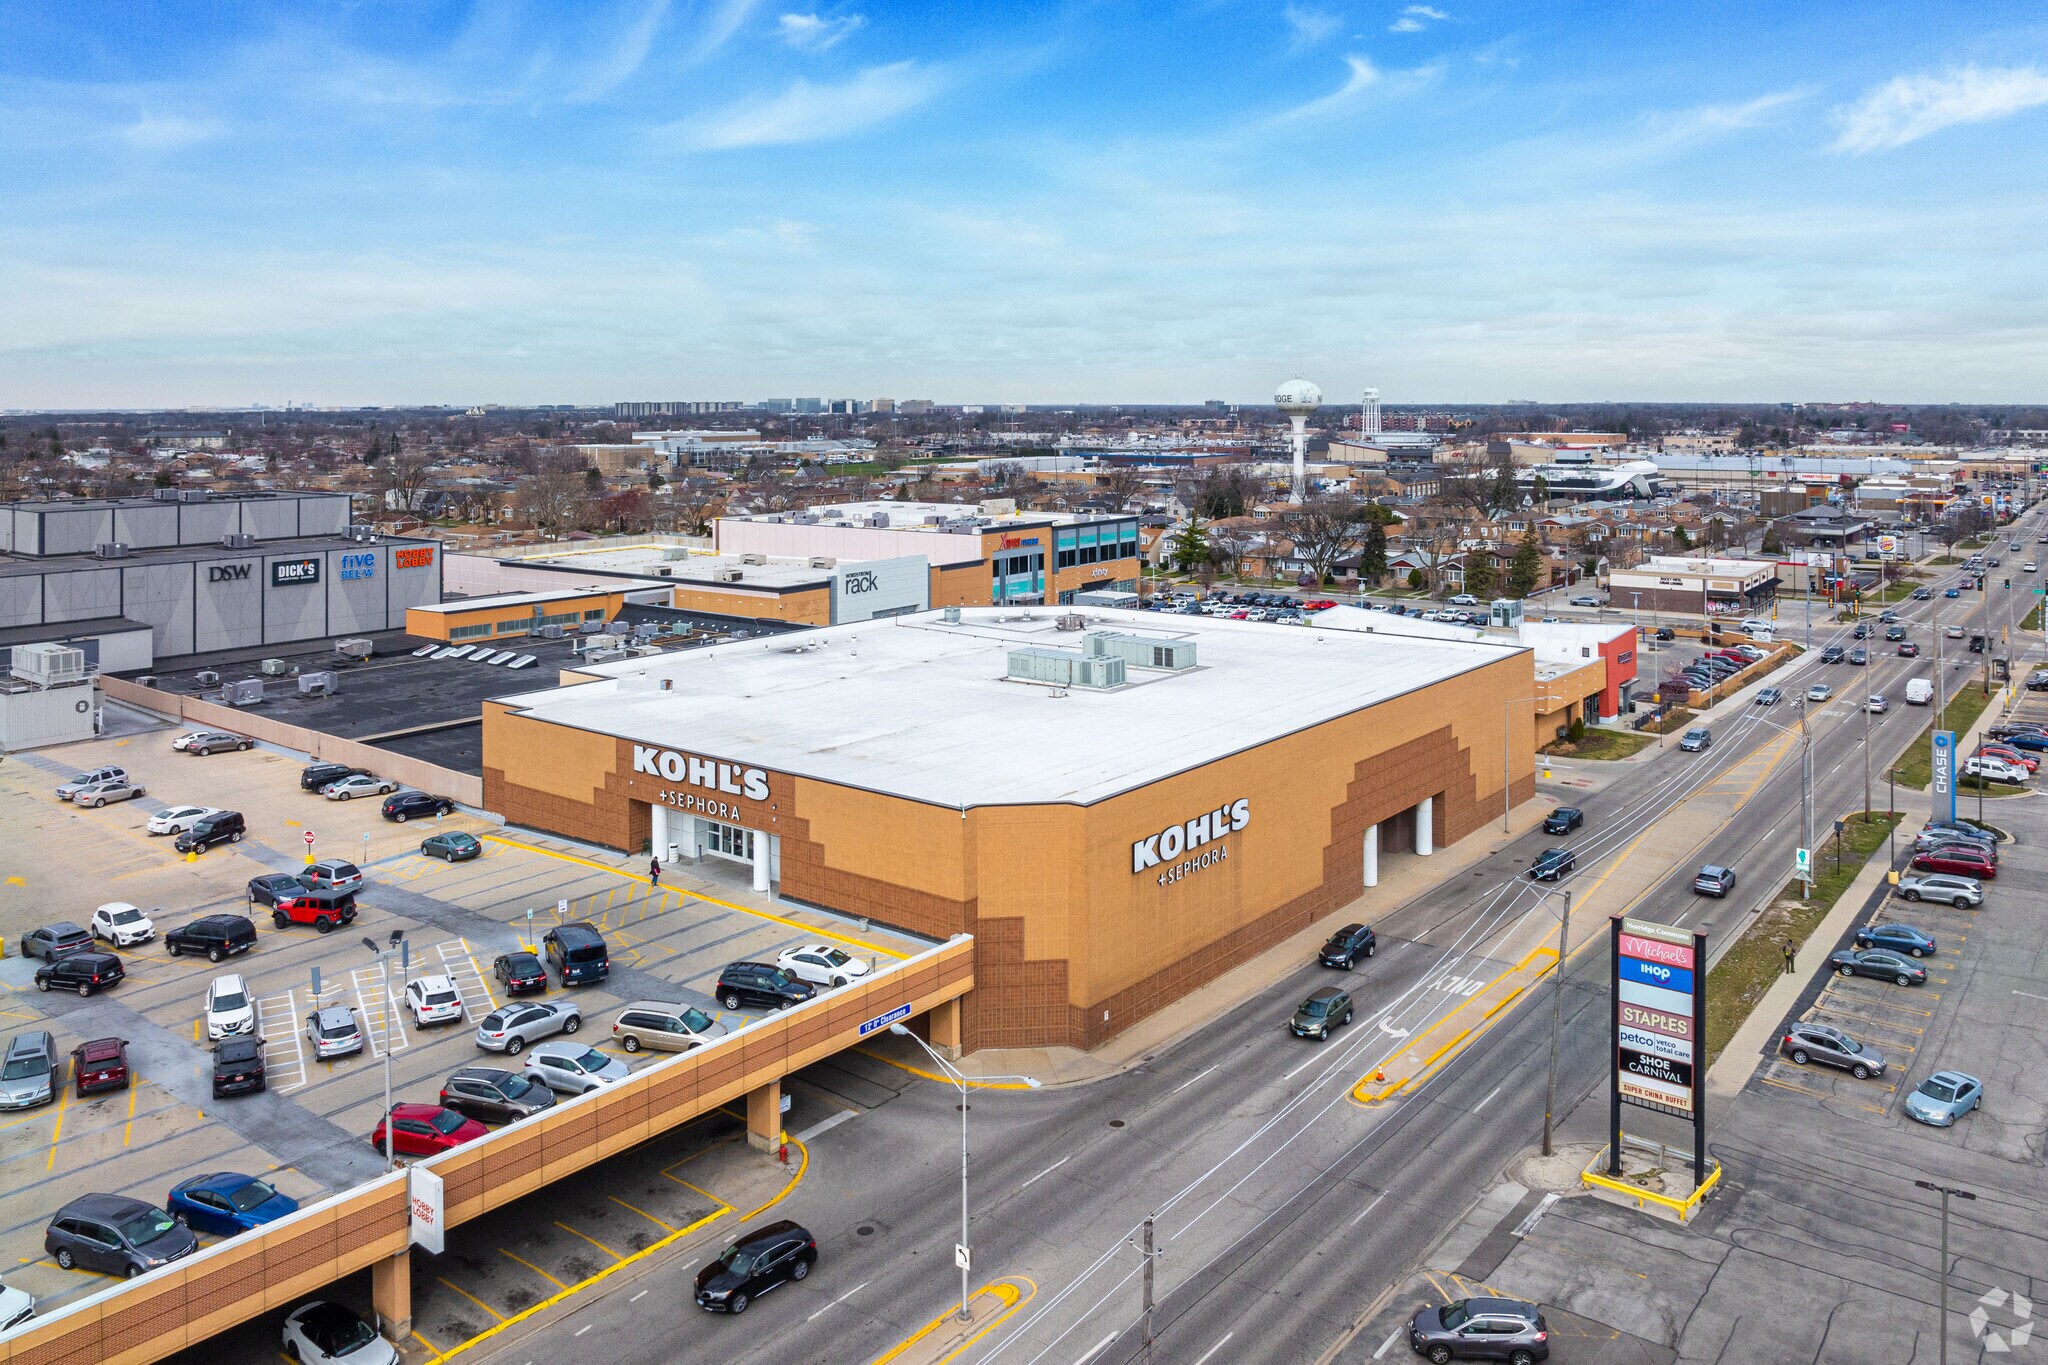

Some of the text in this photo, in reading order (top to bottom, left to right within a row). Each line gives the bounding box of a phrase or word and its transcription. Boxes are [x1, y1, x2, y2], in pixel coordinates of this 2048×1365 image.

[341, 553, 375, 569] five
[396, 548, 433, 559] HOBBY
[278, 561, 315, 578] DICK'S
[397, 557, 432, 569] LOBBY
[208, 564, 252, 582] DSW
[845, 571, 878, 594] rack
[633, 744, 770, 801] KOHL'S
[1936, 748, 1947, 793] CHASE
[1132, 798, 1250, 873] KOHL'S
[1626, 922, 1690, 941] Norridge Commons
[1625, 937, 1687, 967] Michaels
[1640, 963, 1671, 980] IHOP
[880, 1008, 907, 1025] Clearance
[1623, 1007, 1688, 1035] STAPLES
[1620, 1031, 1654, 1047] petco
[1656, 1038, 1676, 1048] vetco
[1656, 1045, 1690, 1059] total care
[1639, 1054, 1670, 1071] SHOE
[1623, 1084, 1688, 1107] SUPER CHINA BUFFET
[412, 1195, 434, 1216] HOBBY
[412, 1206, 434, 1225] LOBBY
